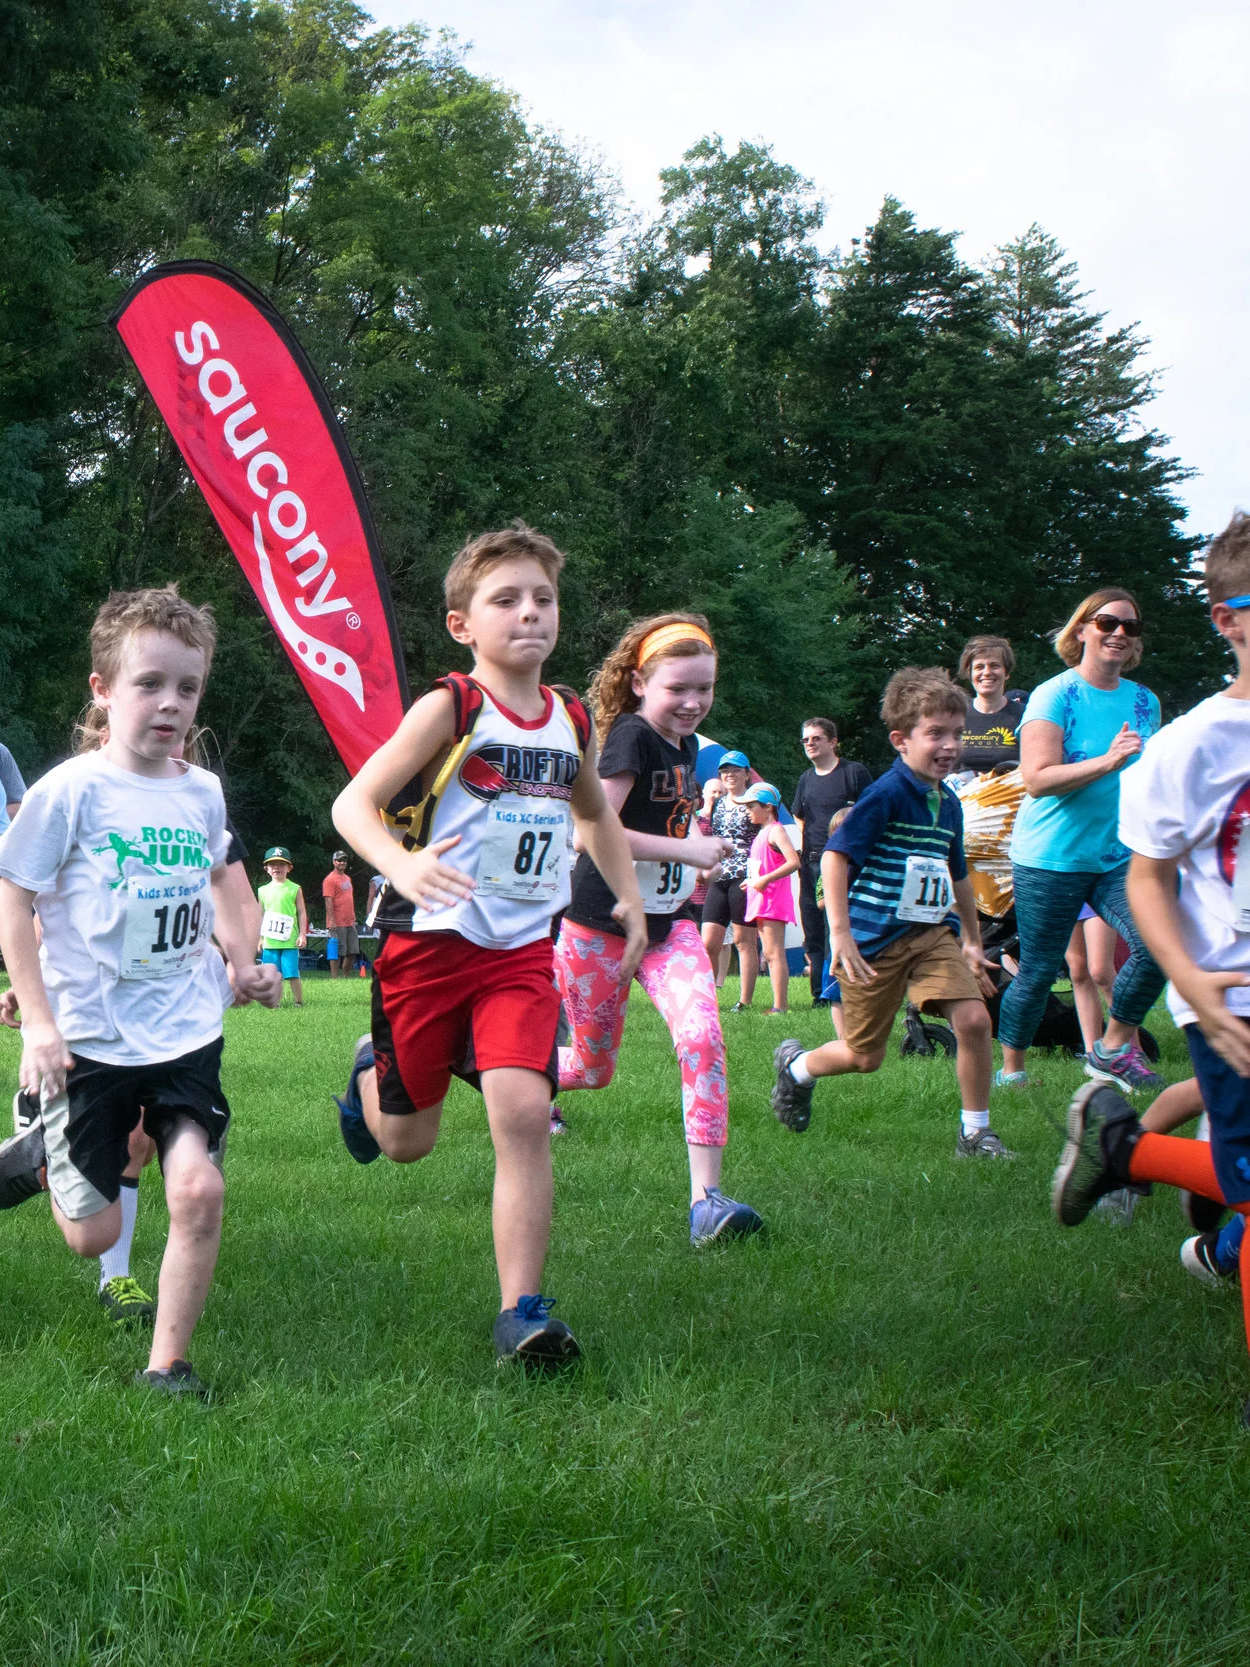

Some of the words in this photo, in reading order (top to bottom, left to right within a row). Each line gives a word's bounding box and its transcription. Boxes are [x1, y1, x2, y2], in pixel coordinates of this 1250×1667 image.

[175, 320, 353, 618] saucony
[495, 810, 517, 823] Kids
[519, 813, 532, 824] XC
[514, 831, 553, 876] 87
[137, 887, 161, 899] Kids
[163, 886, 176, 897] XC
[656, 862, 683, 895] 39
[151, 899, 201, 953] 109
[268, 920, 285, 934] 111
